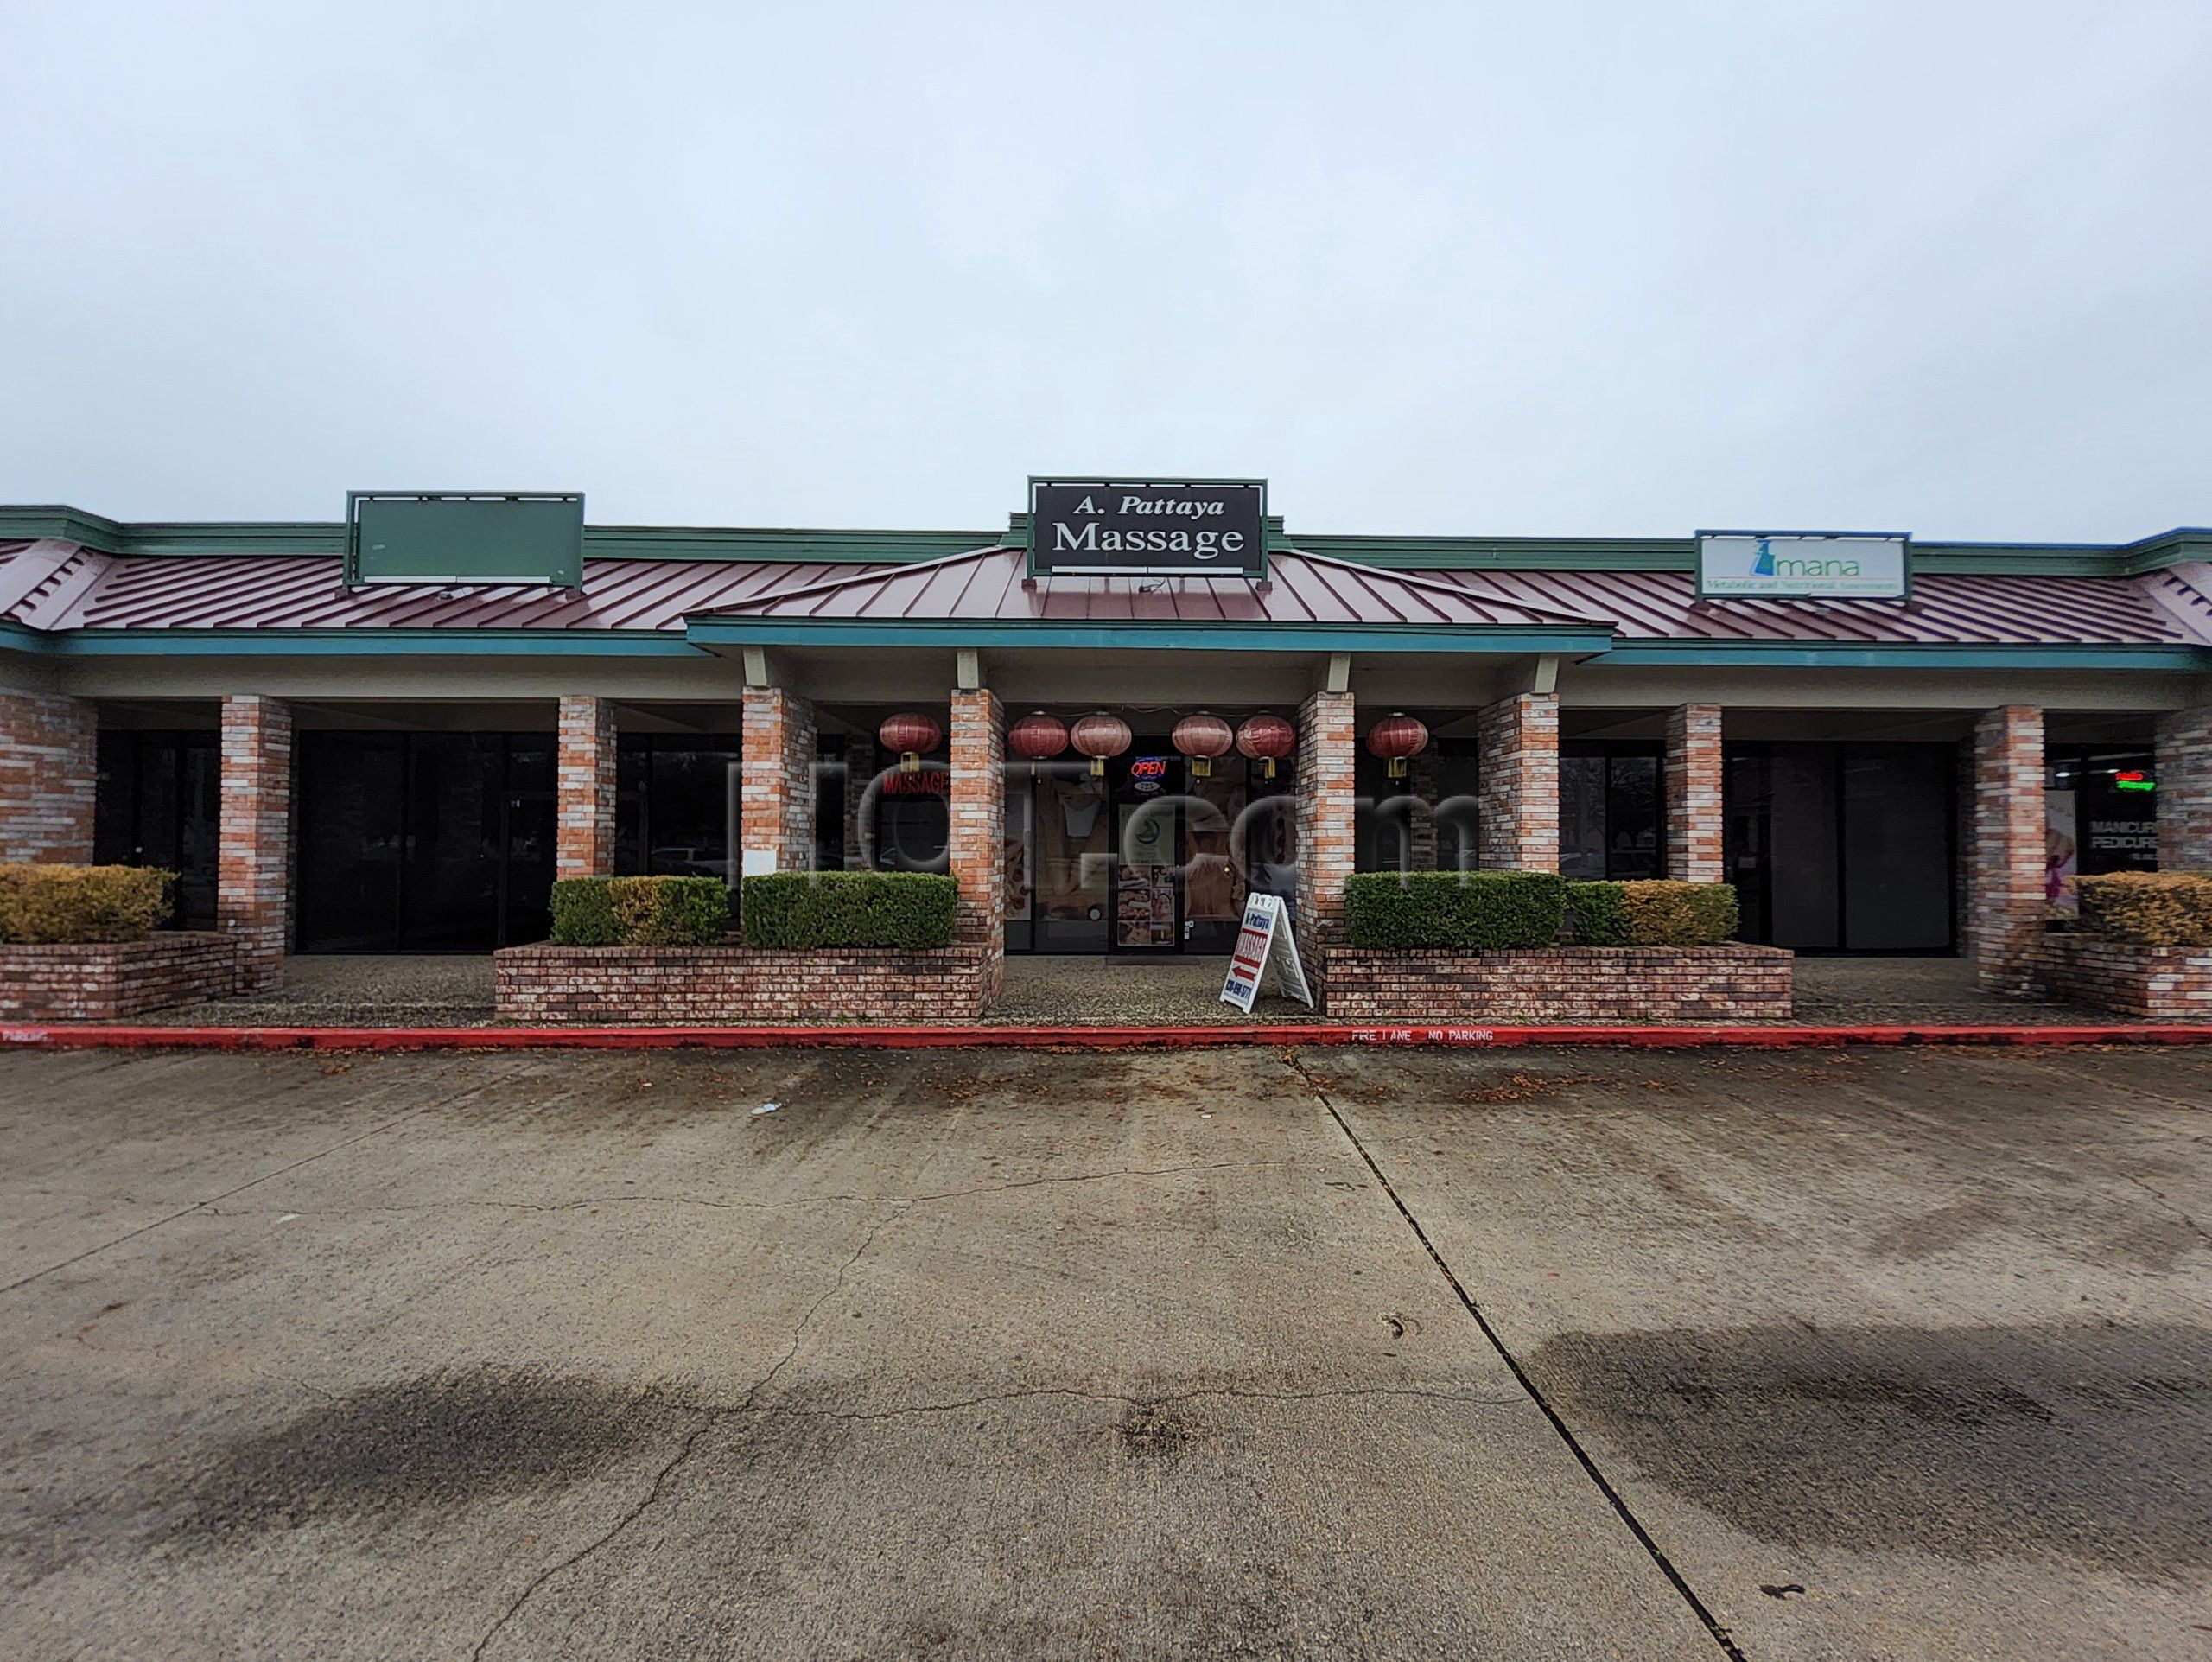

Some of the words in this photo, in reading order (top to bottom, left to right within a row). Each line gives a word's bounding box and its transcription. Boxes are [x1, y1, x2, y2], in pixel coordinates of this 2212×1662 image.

[1072, 495, 1105, 514] A.
[1117, 496, 1224, 519] Pattaya
[1052, 522, 1244, 560] Massage
[1131, 761, 1166, 775] OPEN
[884, 771, 950, 794] MASSAGE
[2090, 821, 2158, 833] MANICUR
[1351, 1029, 1376, 1041] FIRE
[1428, 1029, 1443, 1041] NO
[1448, 1029, 1493, 1041] PARKING
